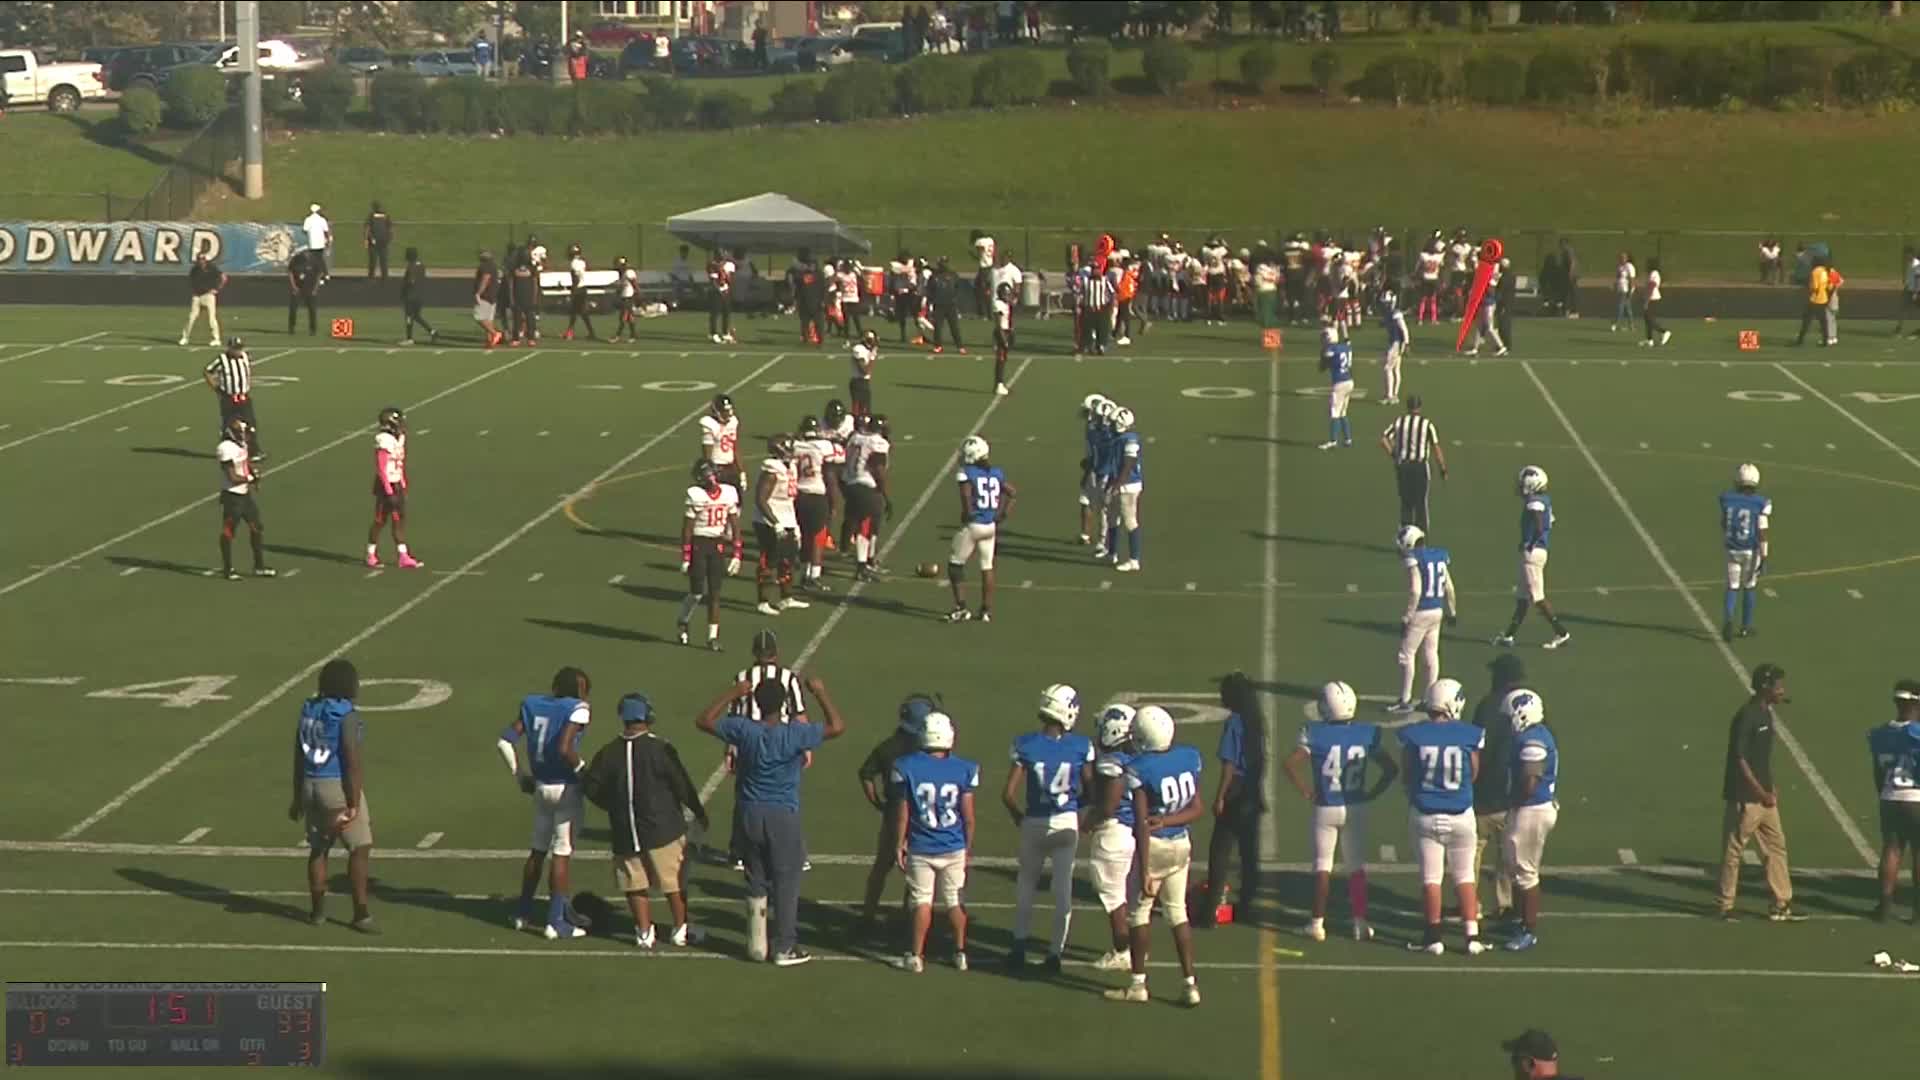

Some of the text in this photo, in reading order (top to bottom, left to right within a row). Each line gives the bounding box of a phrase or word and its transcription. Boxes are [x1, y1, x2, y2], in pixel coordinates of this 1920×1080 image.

[977, 477, 1000, 509] 52
[1727, 507, 1750, 540] 13
[1425, 562, 1448, 598] 12
[532, 716, 550, 763] 7
[1034, 762, 1074, 807] 14
[1419, 745, 1462, 791] 70
[916, 782, 958, 828] 33
[1159, 771, 1196, 815] 90
